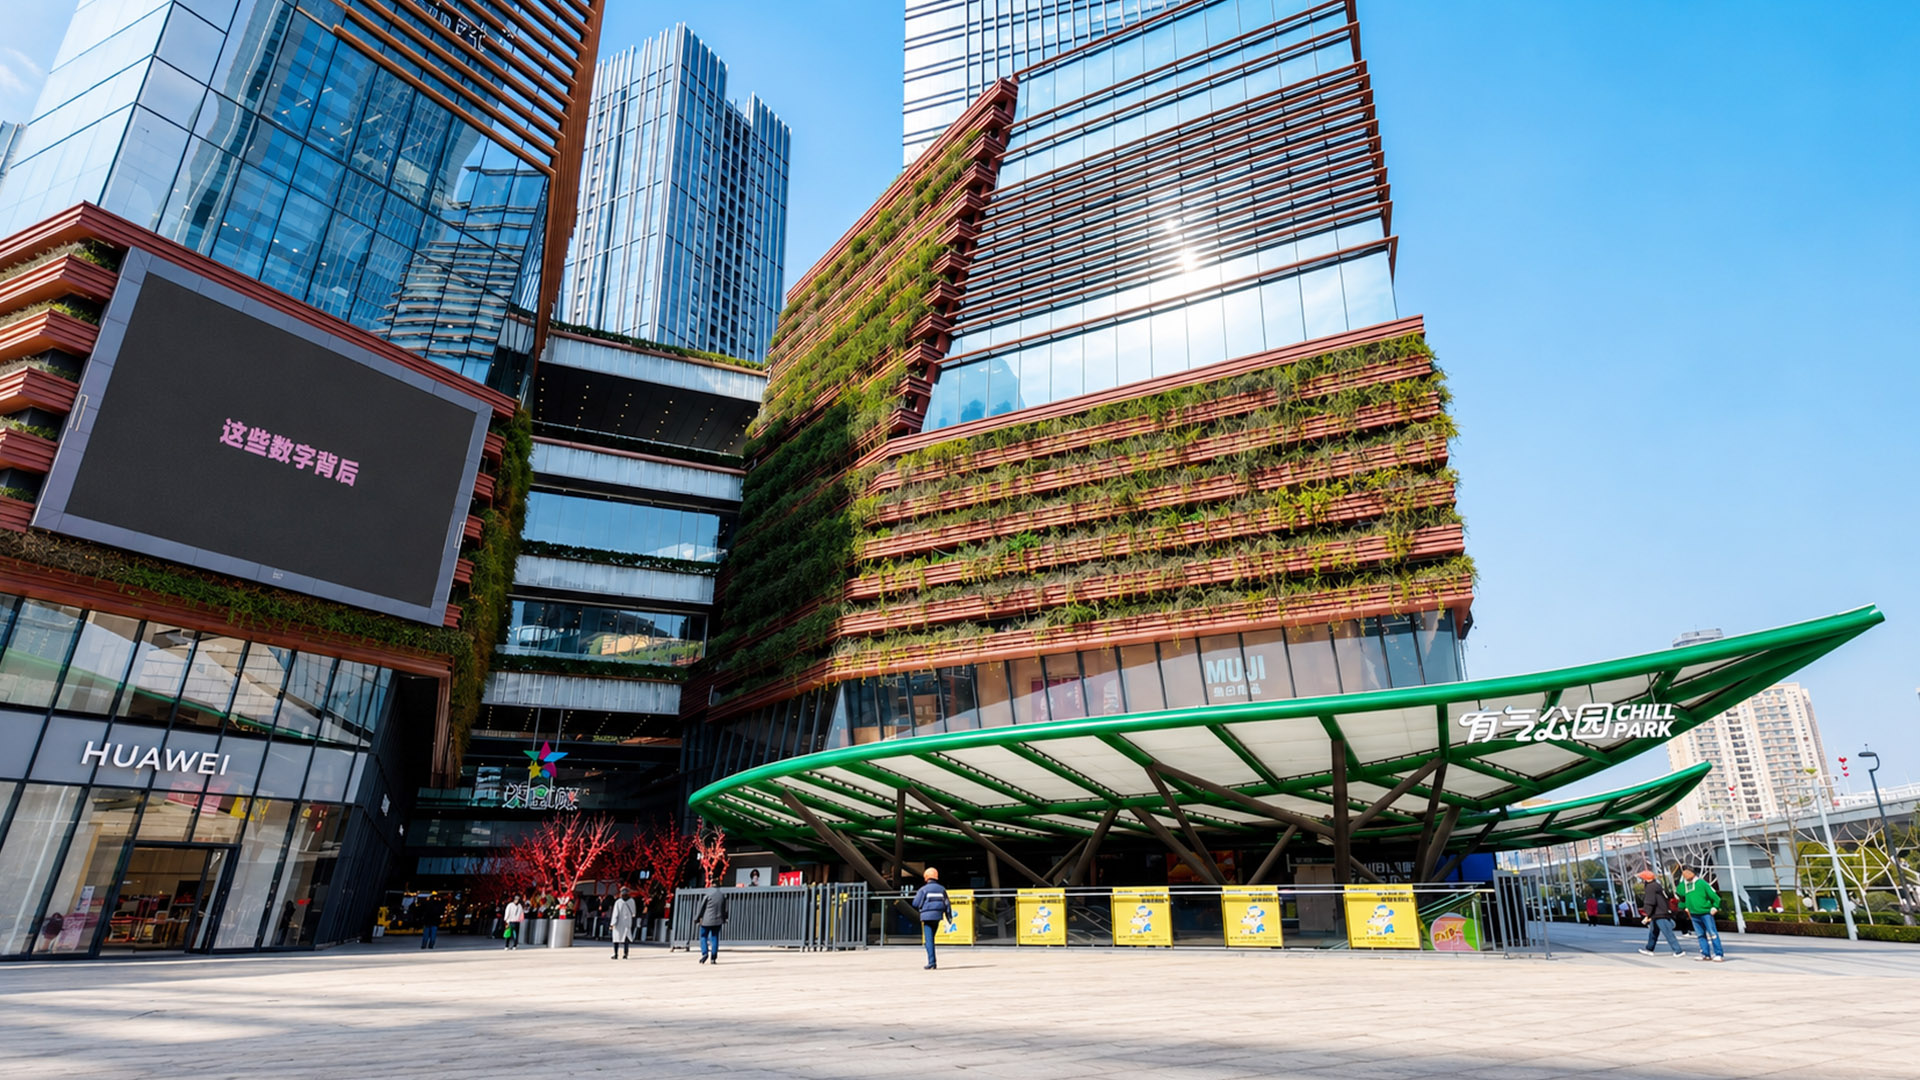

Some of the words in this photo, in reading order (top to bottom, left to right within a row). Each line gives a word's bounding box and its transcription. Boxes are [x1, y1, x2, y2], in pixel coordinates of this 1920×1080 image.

[219, 417, 360, 487] 这些数字背后
[1206, 655, 1266, 684] MUJI
[1616, 703, 1676, 721] CHILL
[1612, 720, 1673, 738] PARK
[80, 740, 231, 776] HUAWEI
